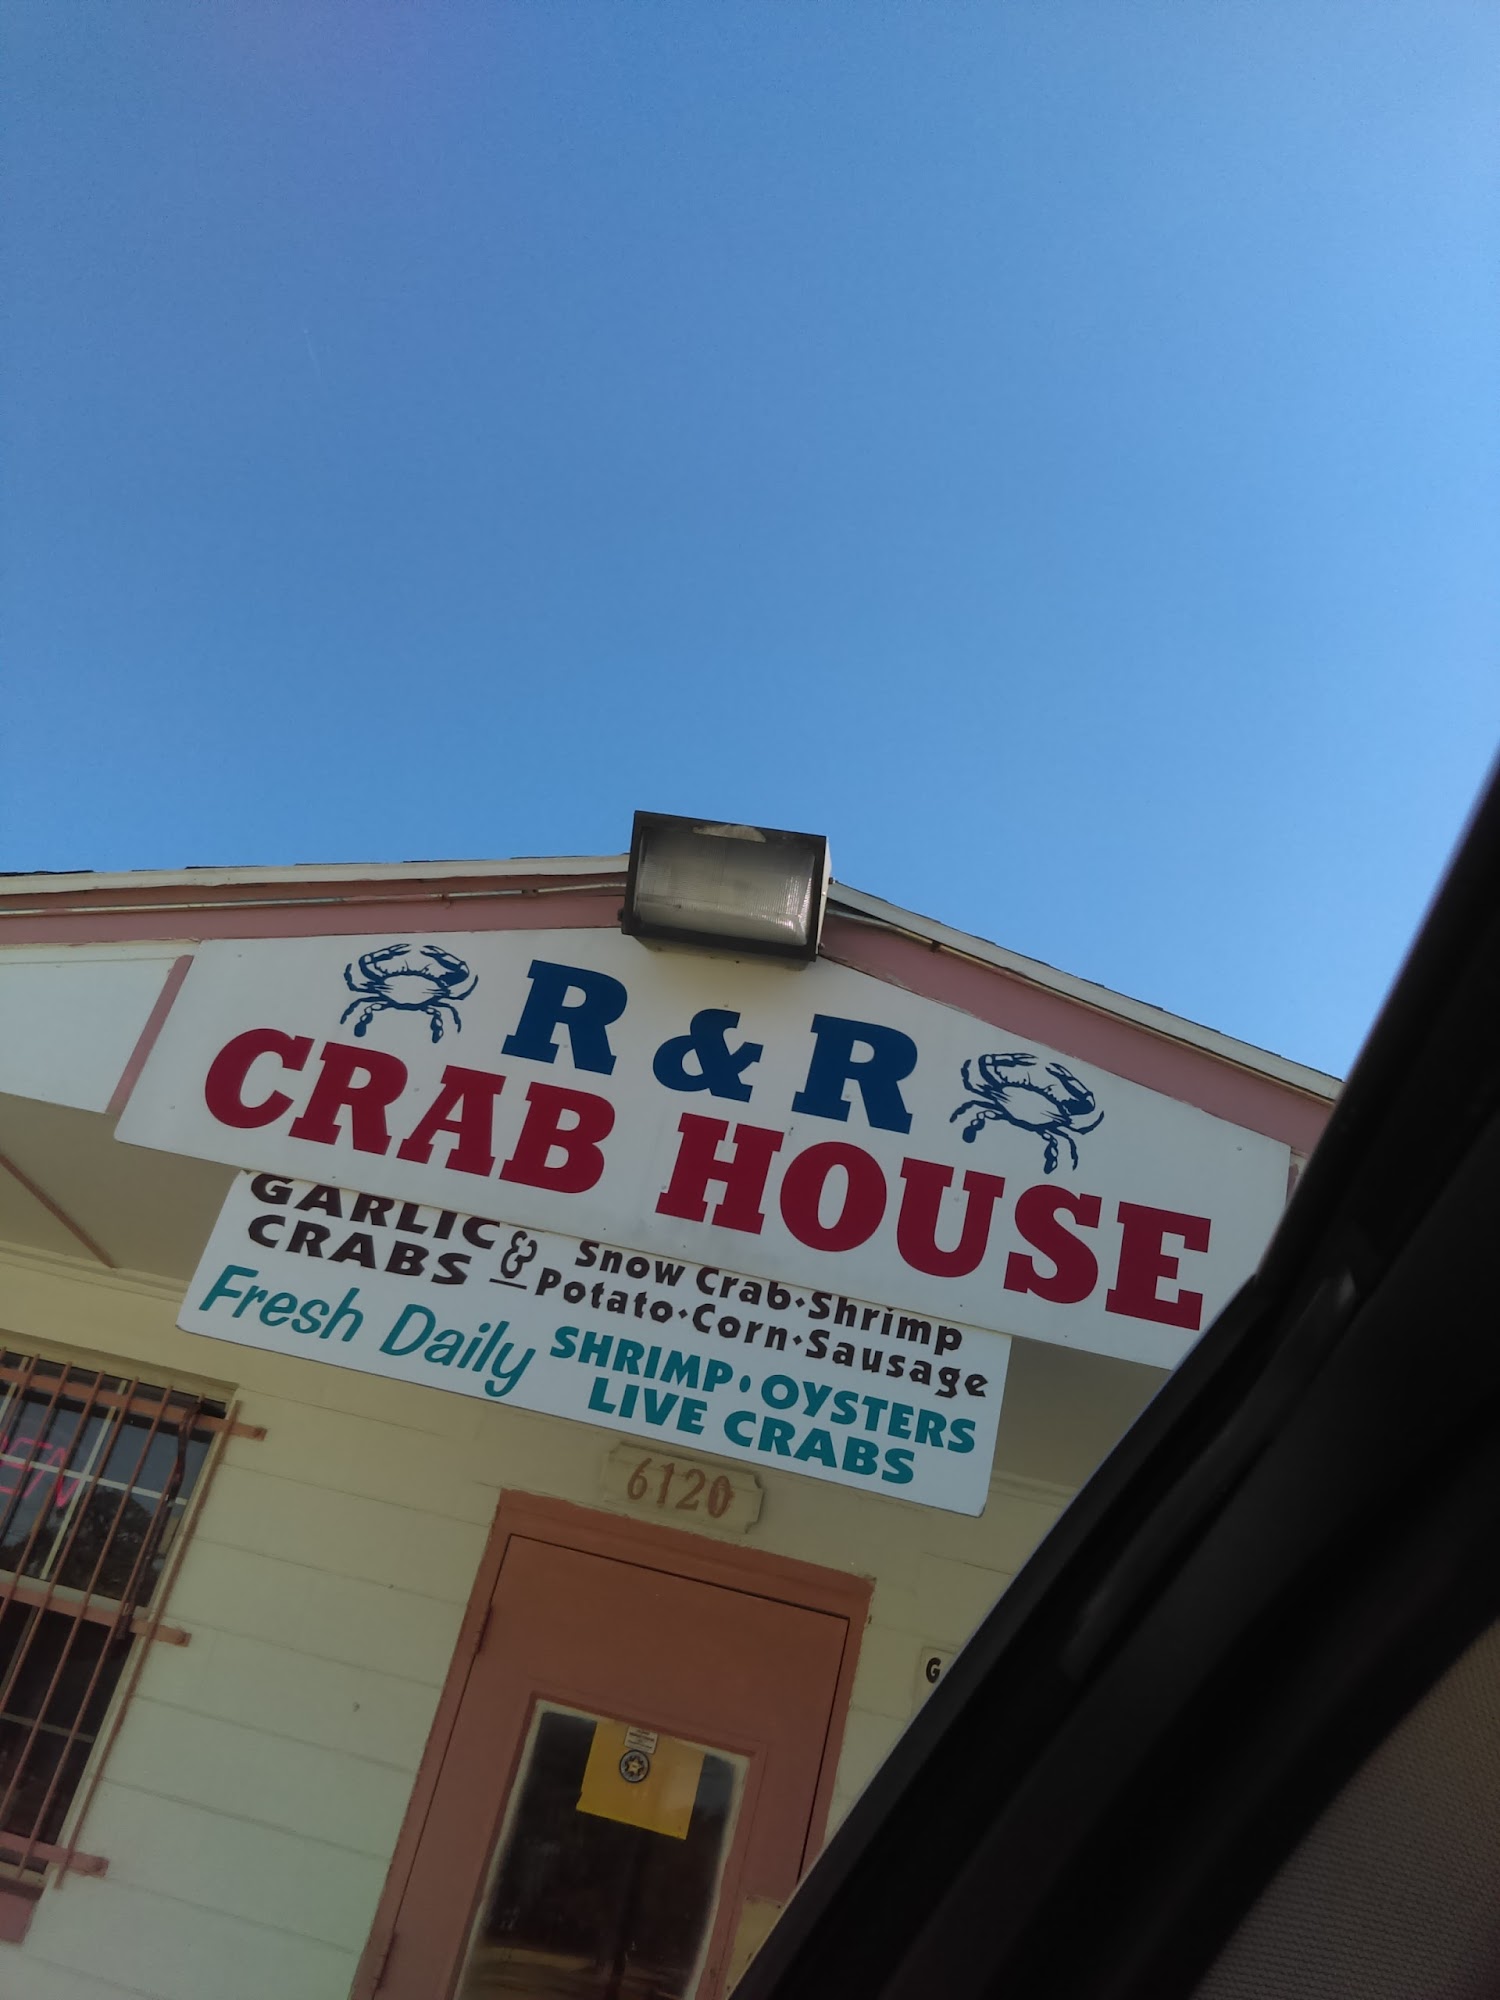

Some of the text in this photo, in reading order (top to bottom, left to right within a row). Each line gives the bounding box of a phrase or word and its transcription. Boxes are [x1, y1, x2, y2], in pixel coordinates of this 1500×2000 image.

[501, 959, 918, 1134] R & R
[204, 1027, 1212, 1331] CRAB HOUSE
[250, 1173, 501, 1250] GARLIC
[247, 1214, 538, 1285] CRABS &
[574, 1239, 686, 1287] Snow
[198, 1264, 537, 1398] Fresh Daily
[550, 1325, 977, 1454] SHRIMP OYSTERS
[587, 1376, 915, 1485] LIVE CRABS
[627, 1457, 735, 1519] 6120
